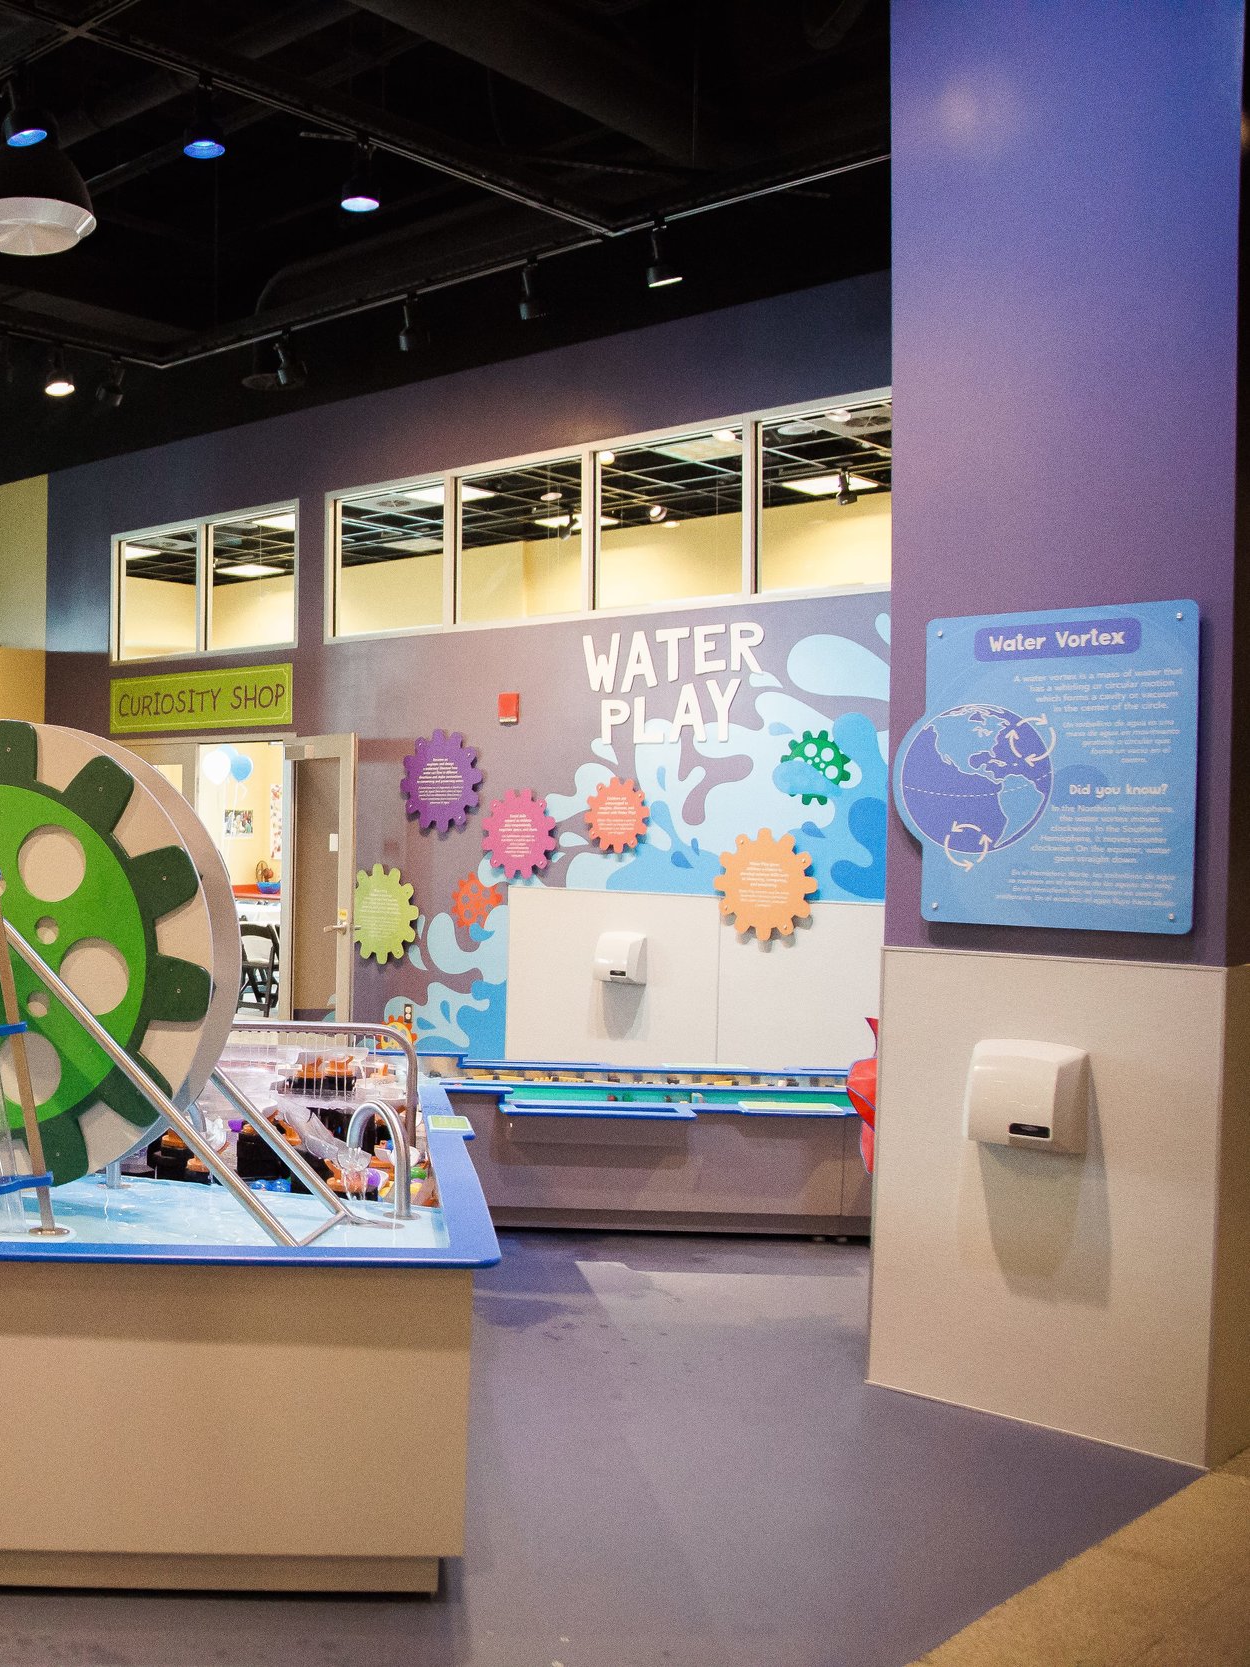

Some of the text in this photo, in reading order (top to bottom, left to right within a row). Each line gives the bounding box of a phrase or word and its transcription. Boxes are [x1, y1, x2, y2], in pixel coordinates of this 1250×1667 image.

[988, 628, 1126, 652] Water Vortex
[582, 621, 765, 694] WATER
[118, 683, 286, 717] CURIOSITY SHOP
[600, 678, 742, 745] PLAY
[1069, 783, 1169, 798] Did you know?
